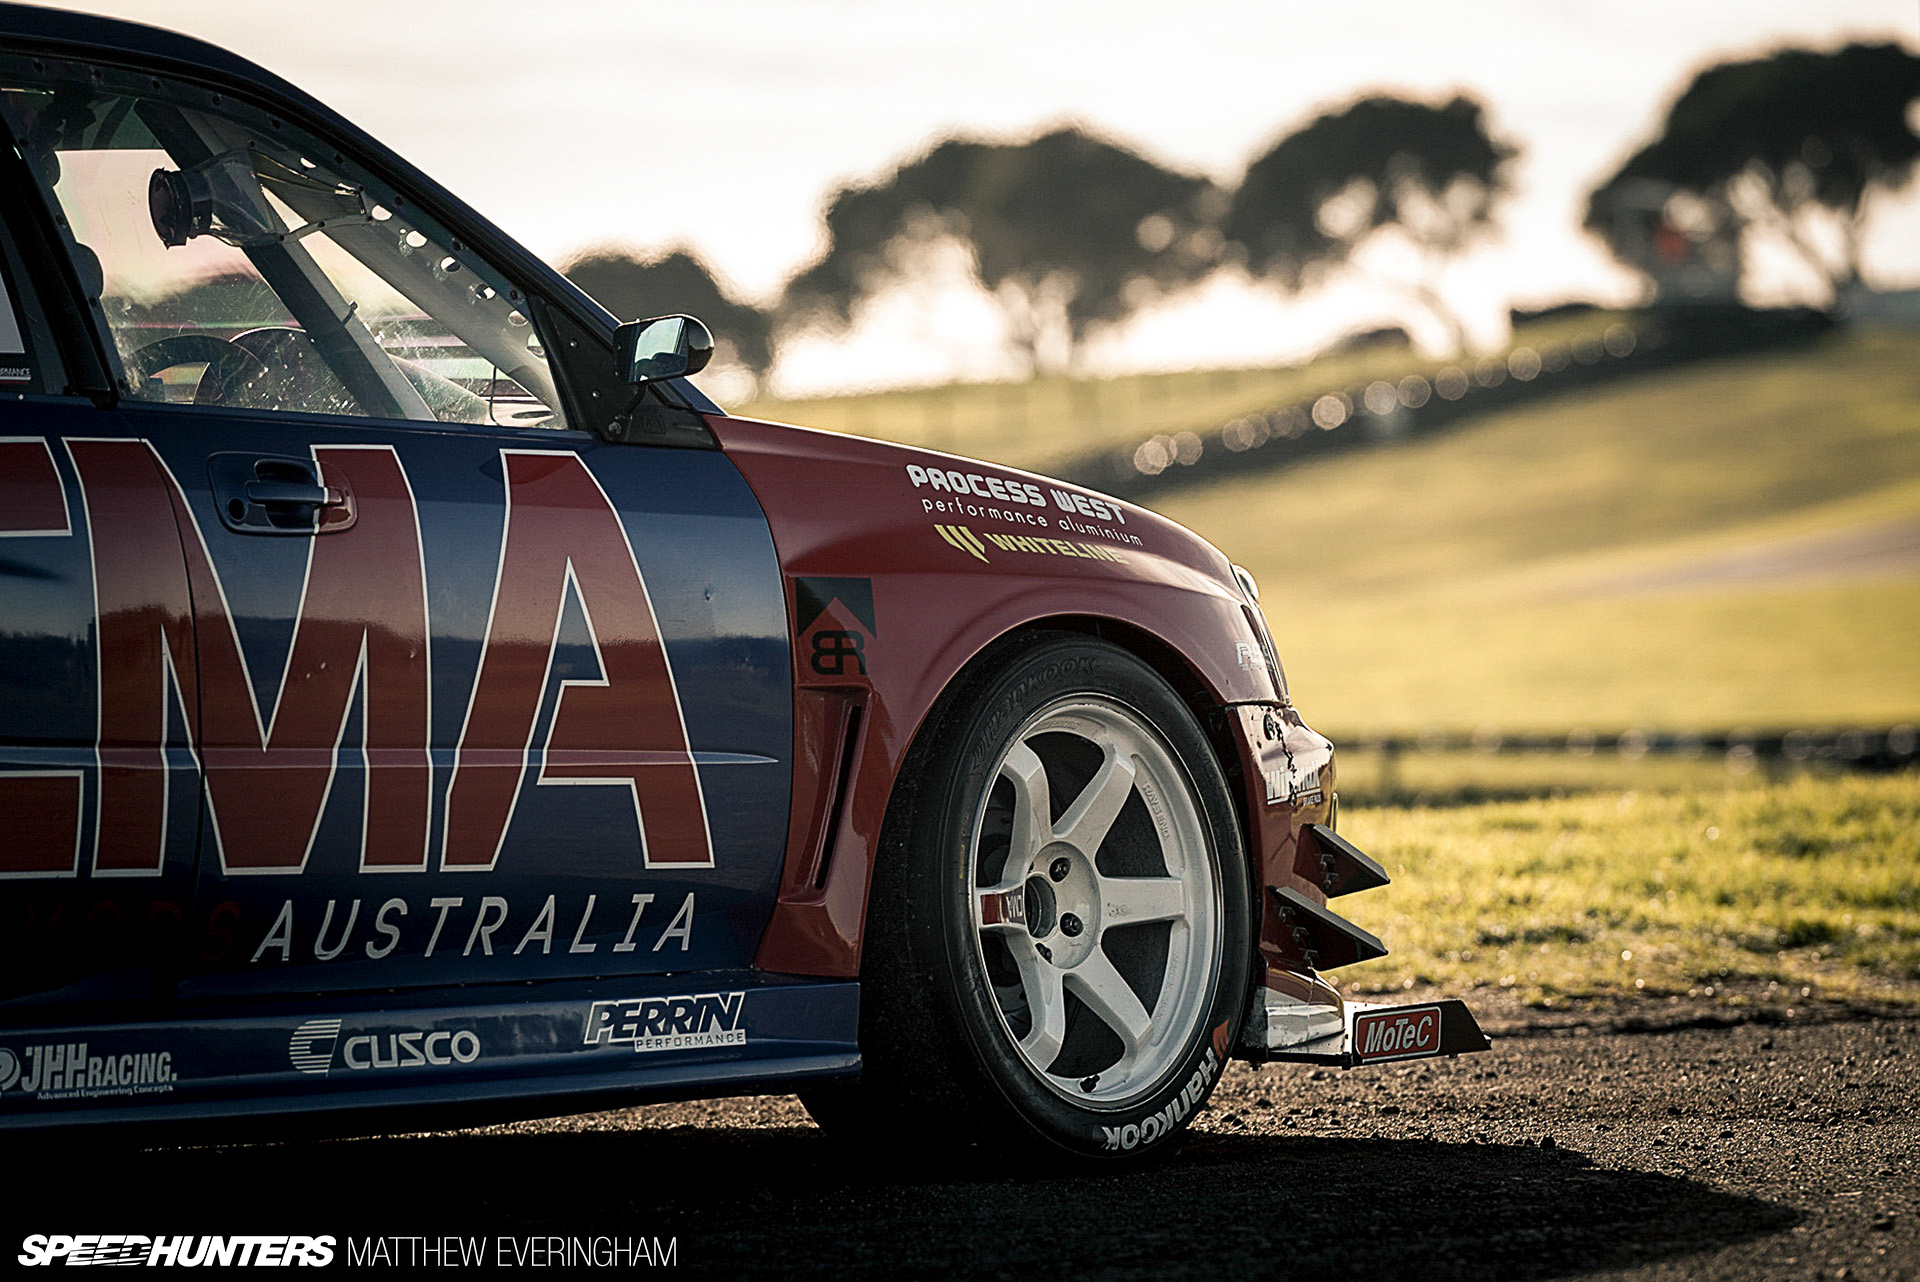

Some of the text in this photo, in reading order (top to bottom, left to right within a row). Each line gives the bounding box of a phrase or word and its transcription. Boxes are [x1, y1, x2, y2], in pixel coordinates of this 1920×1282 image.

[0, 367, 31, 377] MANCE
[906, 464, 1125, 525] PROCESS WEST
[921, 497, 1143, 547] performance aluminium
[983, 533, 1131, 565] WHITELINE
[250, 892, 695, 962] AUSTRALIA
[584, 991, 745, 1044] PERRIN
[1363, 1015, 1433, 1054] MoTeC
[343, 1030, 481, 1070] CUSCO
[635, 1031, 746, 1051] PERFORMANCE
[37, 1084, 174, 1100] Advanced Engineering Concepts
